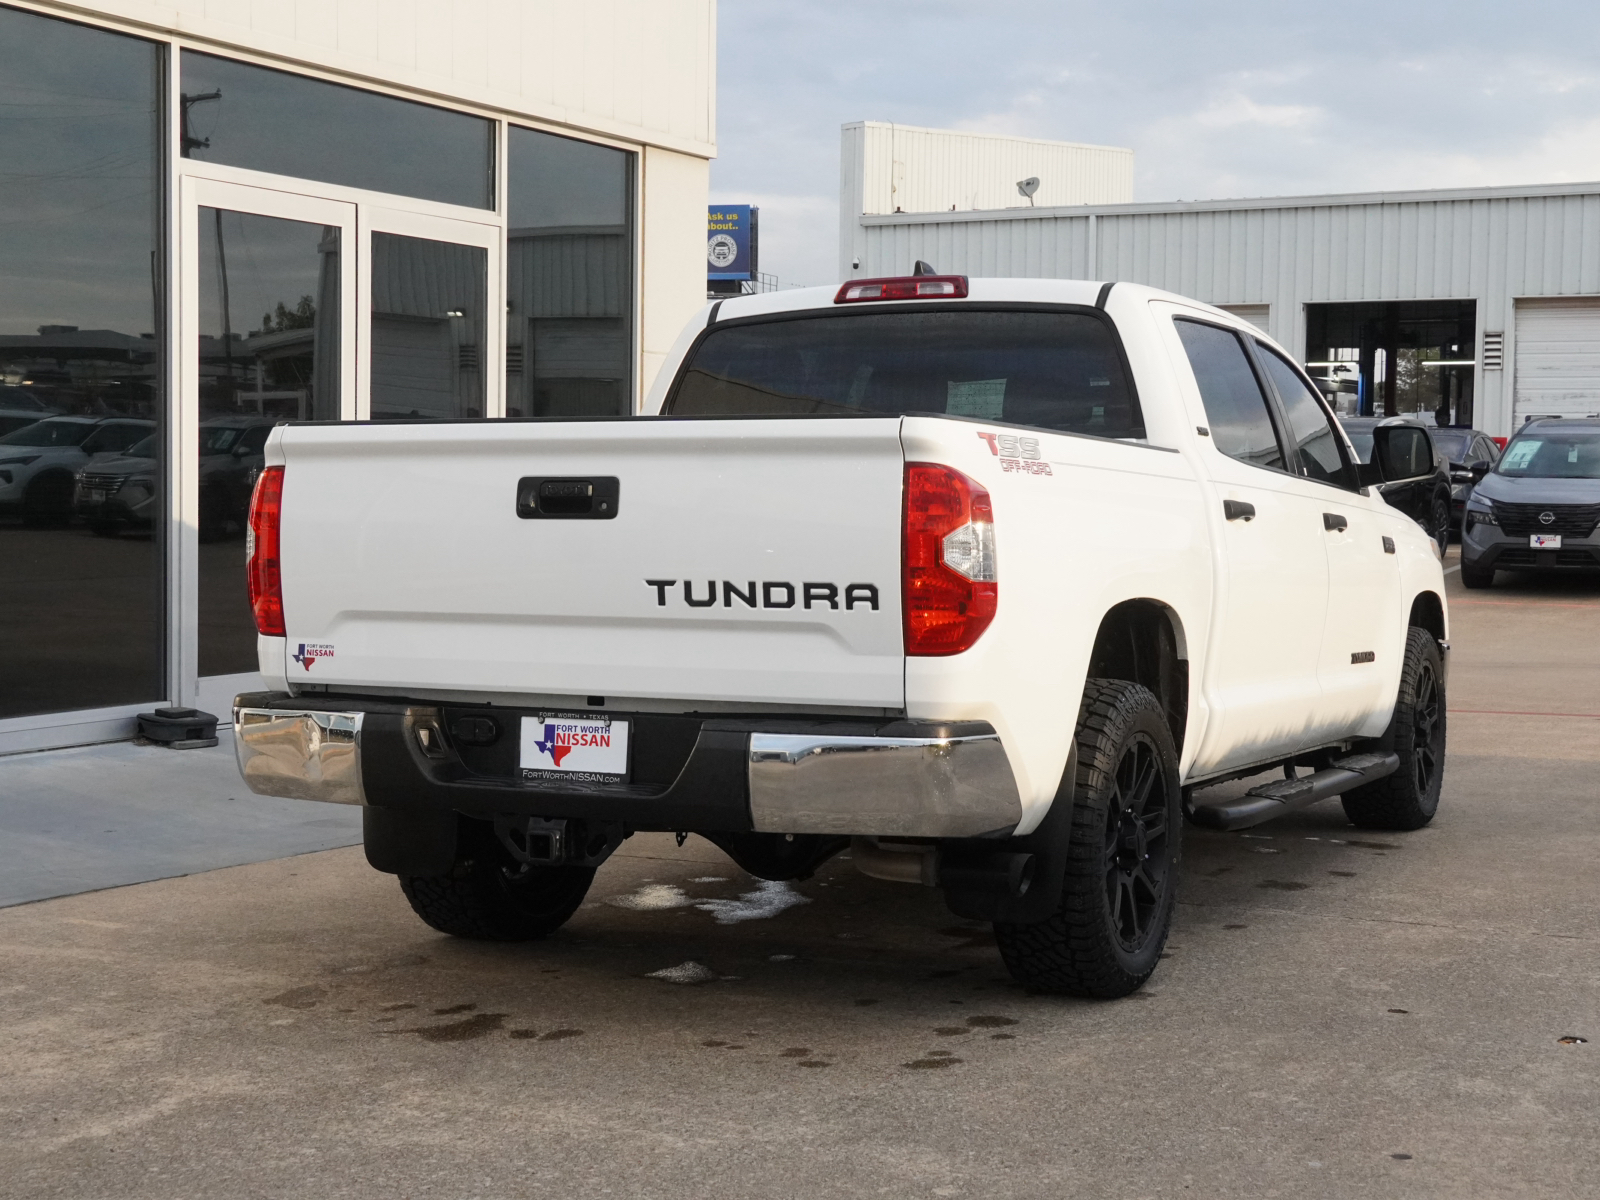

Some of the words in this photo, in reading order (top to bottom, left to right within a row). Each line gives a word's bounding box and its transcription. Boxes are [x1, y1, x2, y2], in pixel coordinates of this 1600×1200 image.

[976, 432, 1041, 460] TSS
[999, 458, 1053, 476] OFF-ROAD
[645, 579, 880, 611] TUNDRA
[306, 649, 334, 657] NISSAN
[556, 724, 578, 733] FORT
[580, 725, 611, 734] WORTH
[555, 732, 611, 747] NISSAN
